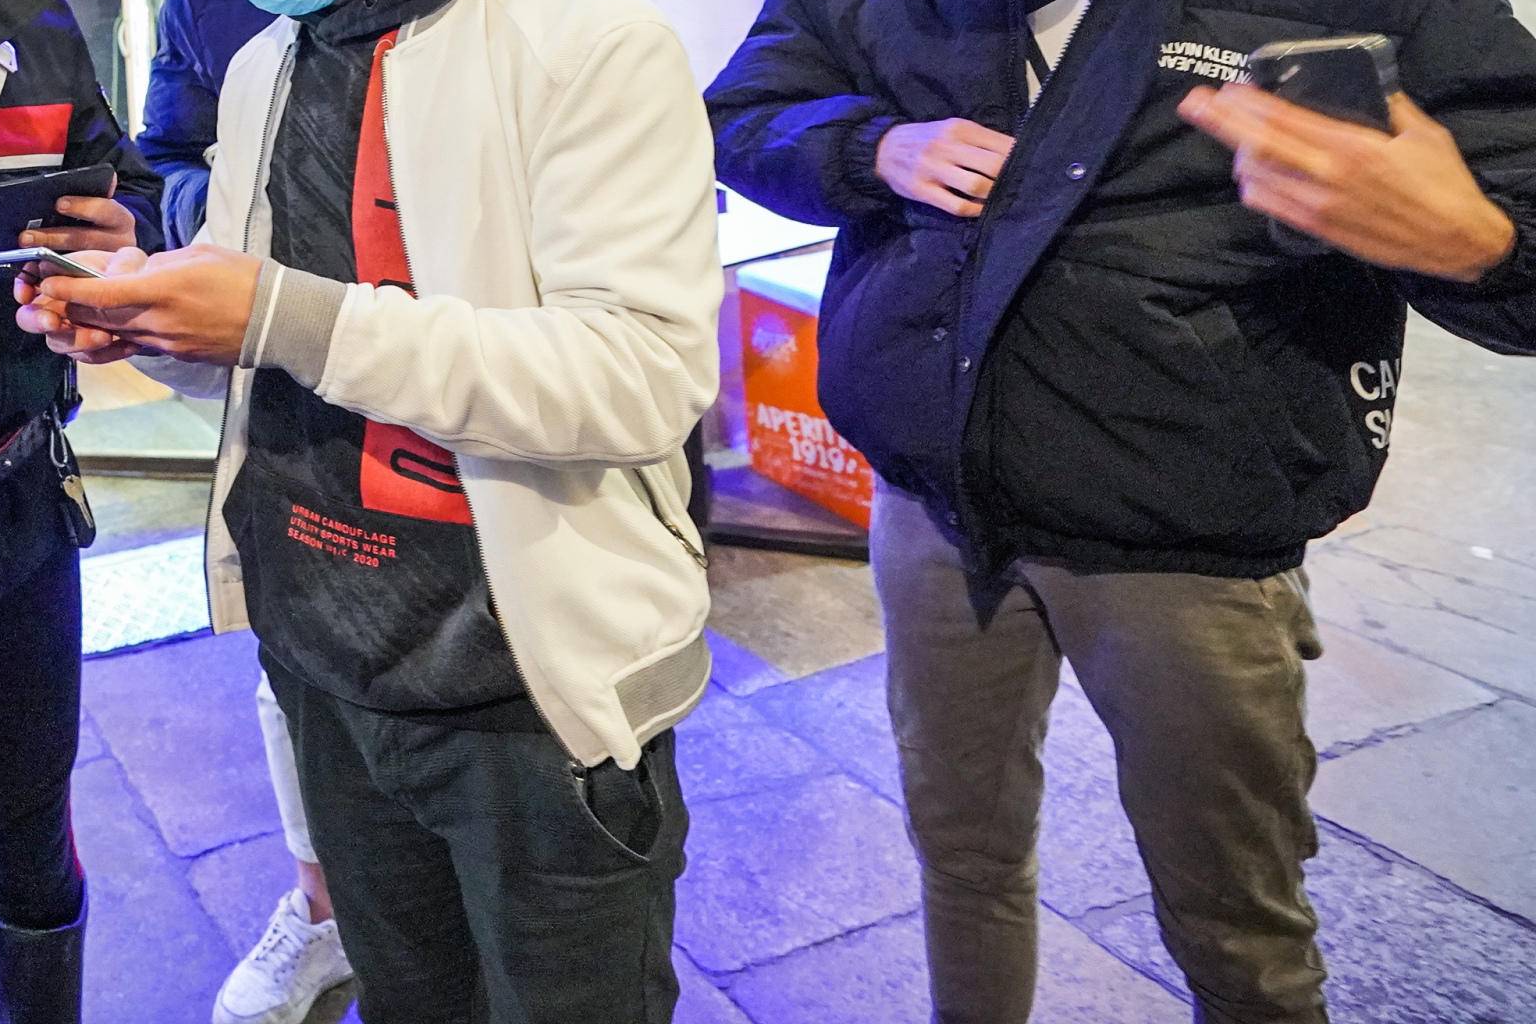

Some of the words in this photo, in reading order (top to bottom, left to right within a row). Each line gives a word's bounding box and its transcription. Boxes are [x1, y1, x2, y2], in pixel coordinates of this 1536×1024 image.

[289, 516, 320, 534] UTILITY
[320, 529, 359, 550] SPORTS
[362, 542, 396, 558] WEAR
[291, 504, 321, 523] URBAN
[321, 517, 396, 546] CAMOUFLAGE
[287, 527, 323, 550] SEASON
[353, 552, 380, 568] 2020
